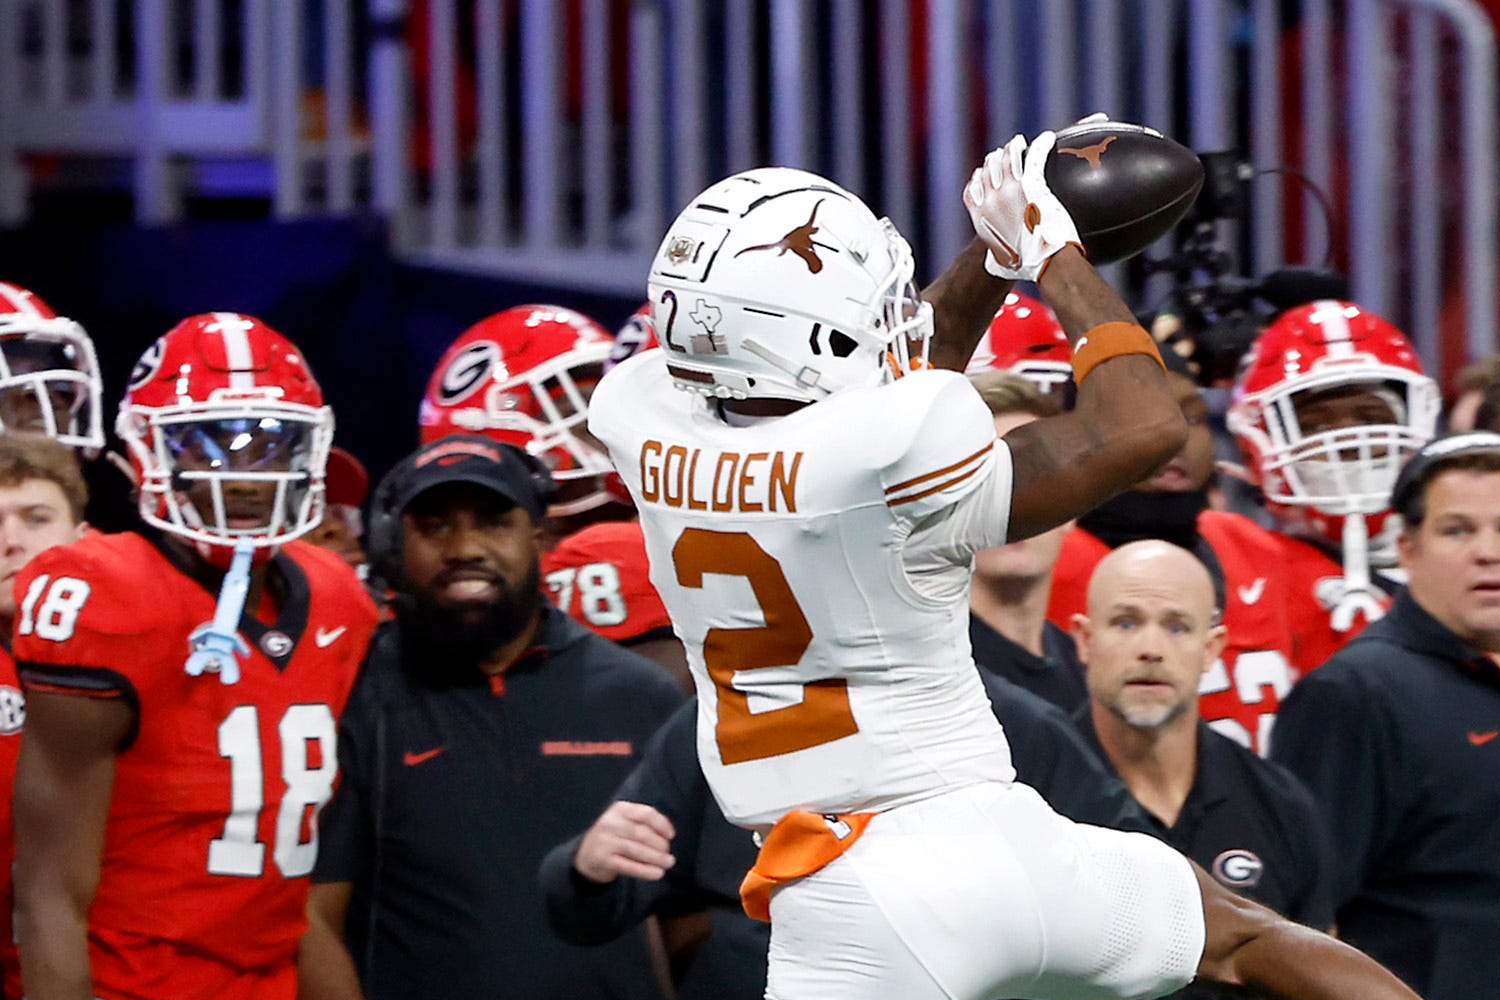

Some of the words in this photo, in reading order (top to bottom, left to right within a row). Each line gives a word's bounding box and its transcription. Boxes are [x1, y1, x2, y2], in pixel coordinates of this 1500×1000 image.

[661, 290, 686, 353] 2
[438, 341, 502, 405] G
[640, 440, 804, 513] GOLDEN
[19, 574, 92, 641] 18
[546, 562, 629, 626] 78
[672, 527, 860, 766] 2
[207, 703, 338, 878] 18
[1212, 849, 1262, 887] G
